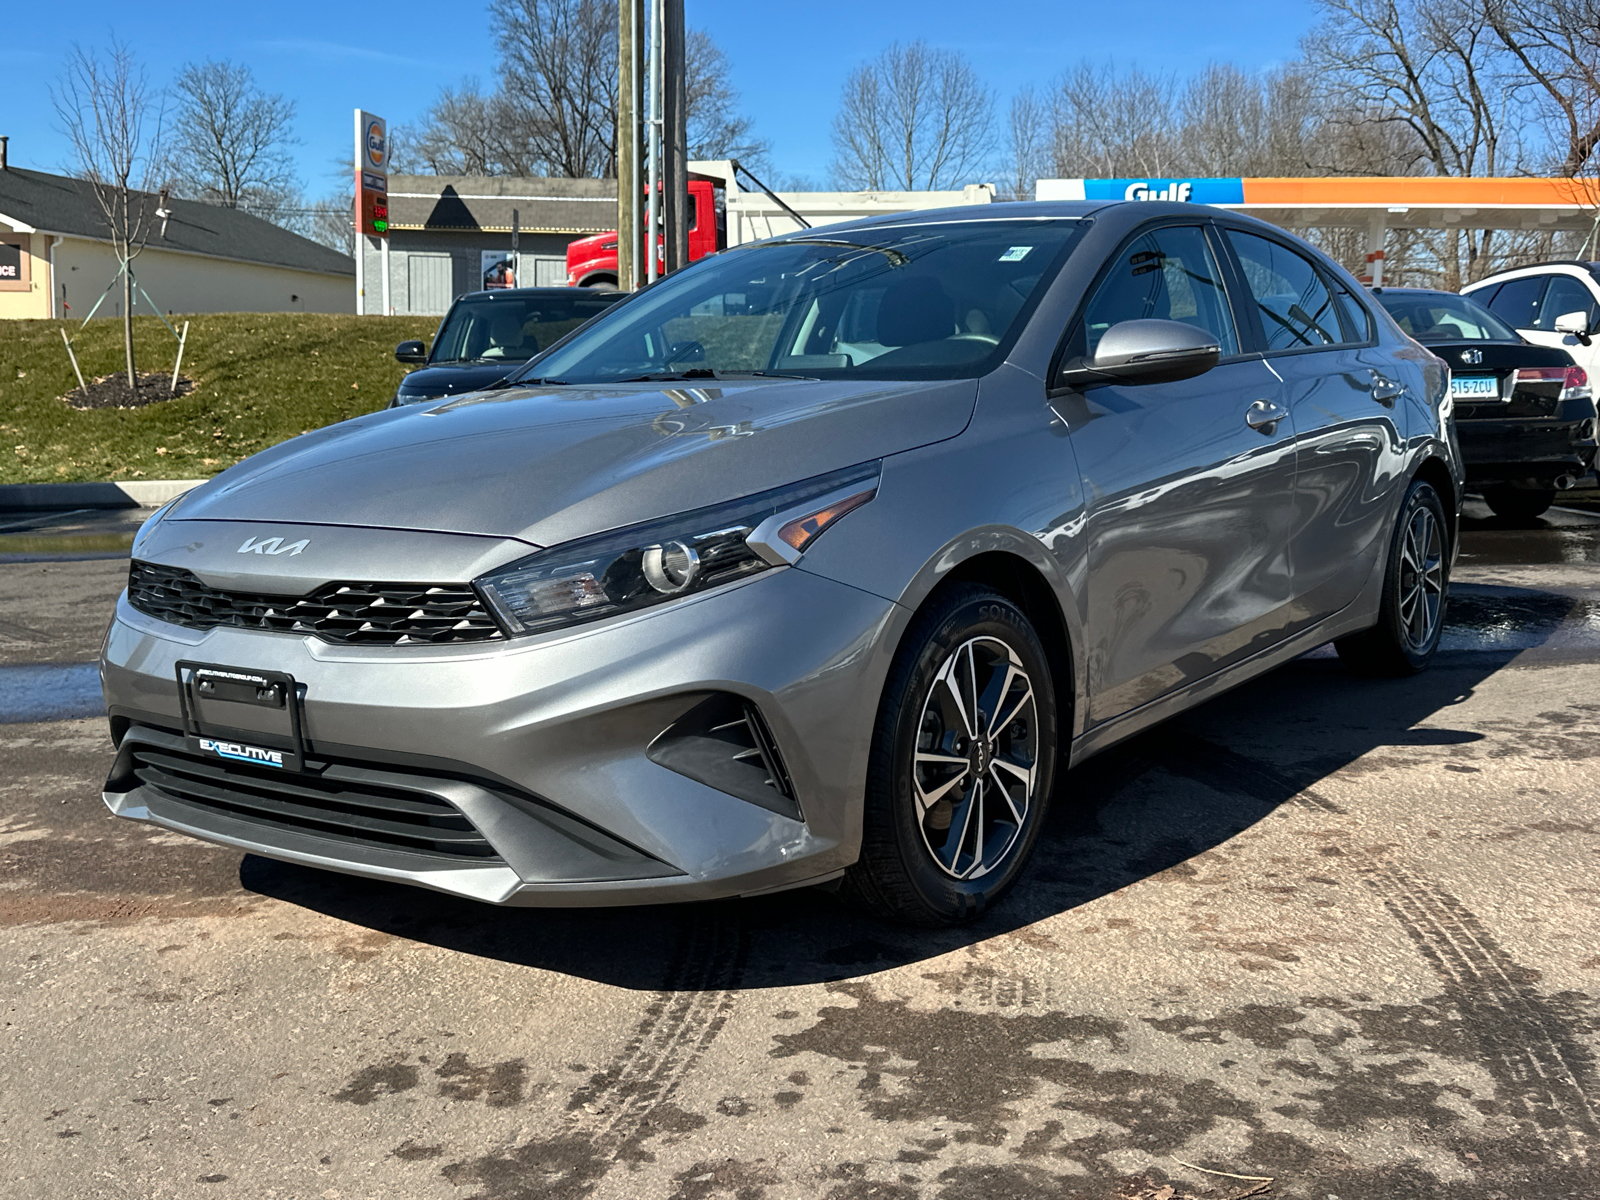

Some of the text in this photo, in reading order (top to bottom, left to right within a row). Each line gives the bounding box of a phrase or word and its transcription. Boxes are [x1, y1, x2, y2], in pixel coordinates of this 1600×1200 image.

[1125, 182, 1193, 202] Gulf
[237, 536, 311, 557] KIA
[199, 738, 283, 765] EXECUTIVE
